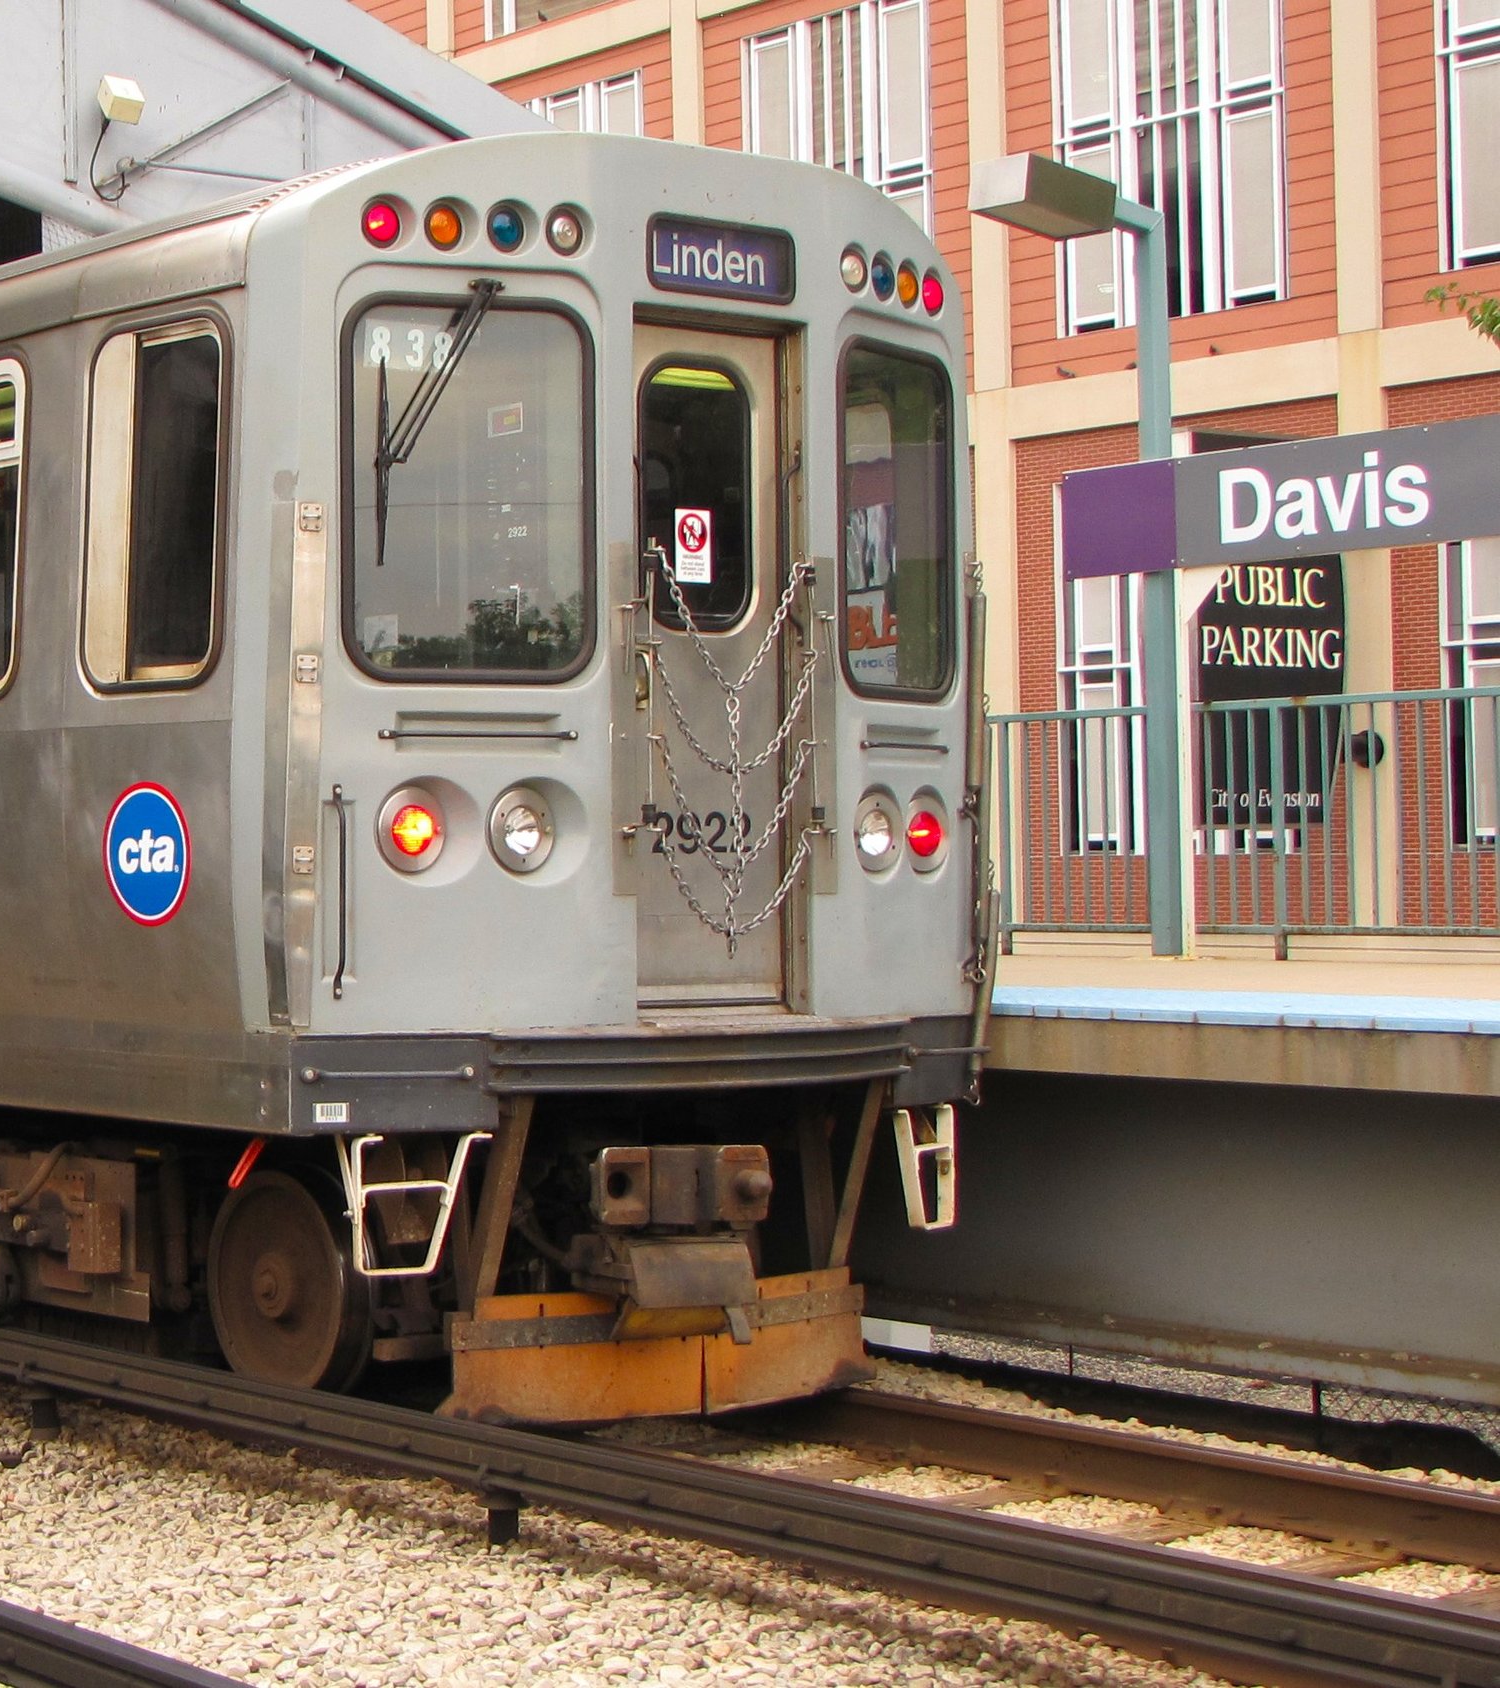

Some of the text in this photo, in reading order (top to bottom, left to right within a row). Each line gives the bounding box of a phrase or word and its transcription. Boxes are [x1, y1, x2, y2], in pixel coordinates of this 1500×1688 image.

[652, 230, 765, 287] Linden
[1219, 450, 1429, 544] Davis
[1215, 565, 1326, 609] PUBLIC
[1201, 625, 1341, 669] PARKING
[118, 828, 175, 875] cta
[652, 811, 752, 854] 2922
